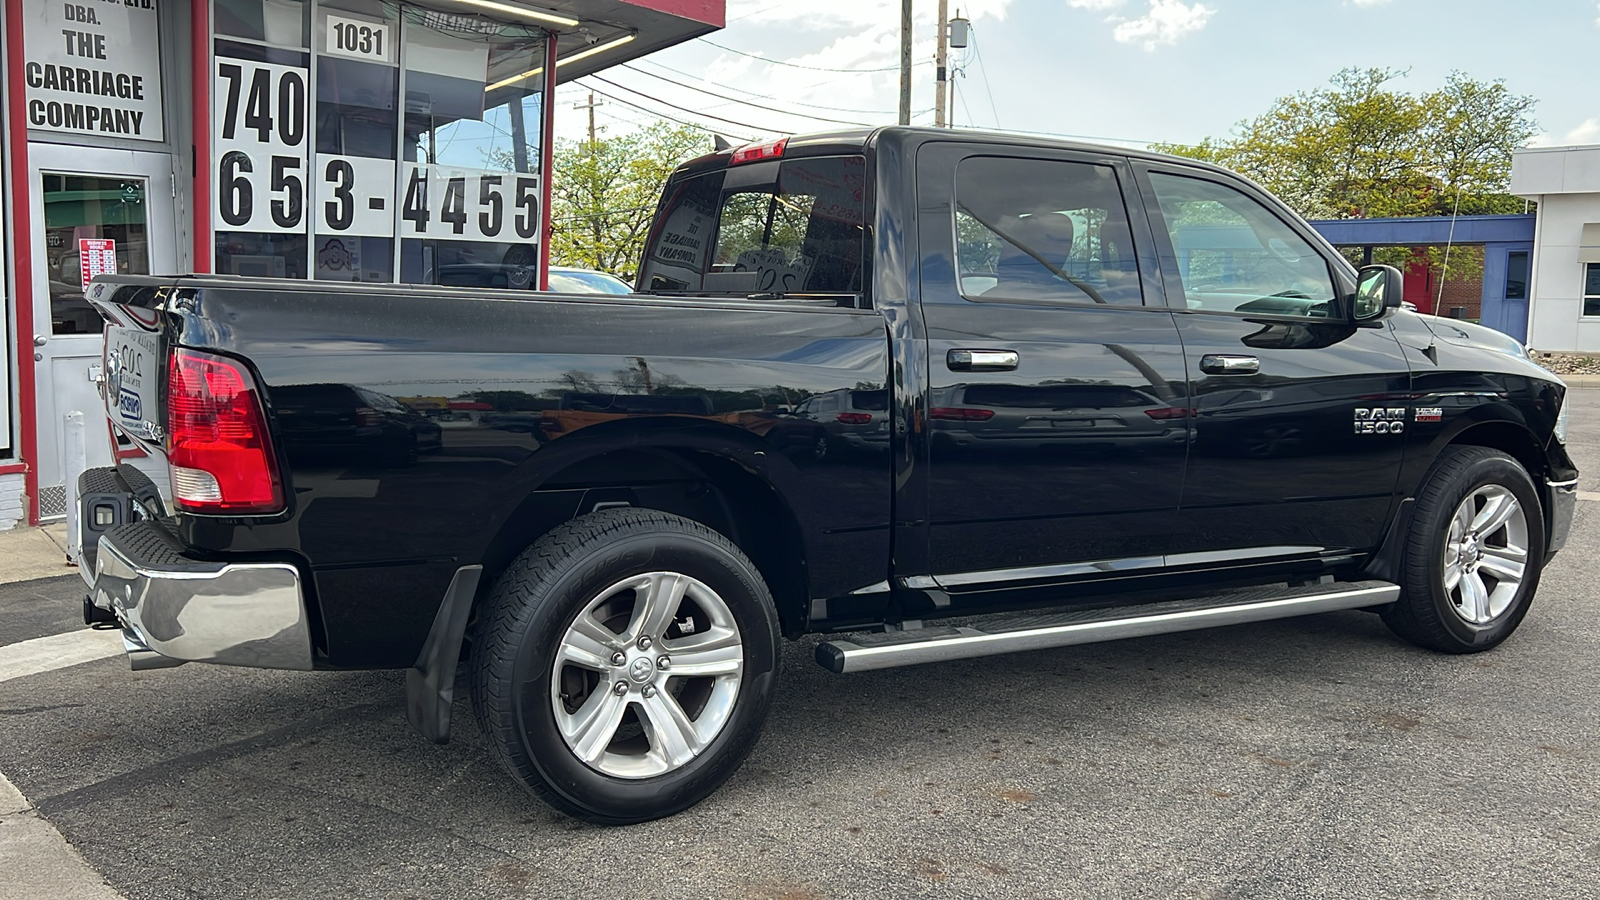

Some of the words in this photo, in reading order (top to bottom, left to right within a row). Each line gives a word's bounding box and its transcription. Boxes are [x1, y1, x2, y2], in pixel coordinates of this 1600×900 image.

[64, 3, 101, 25] DBA.
[62, 29, 107, 60] THE
[333, 22, 383, 56] 1031
[26, 61, 144, 101] CARRIAGE
[29, 99, 144, 136] COMPANY
[219, 63, 305, 147] 740
[1354, 407, 1405, 421] RAM
[1354, 421, 1404, 434] 1500
